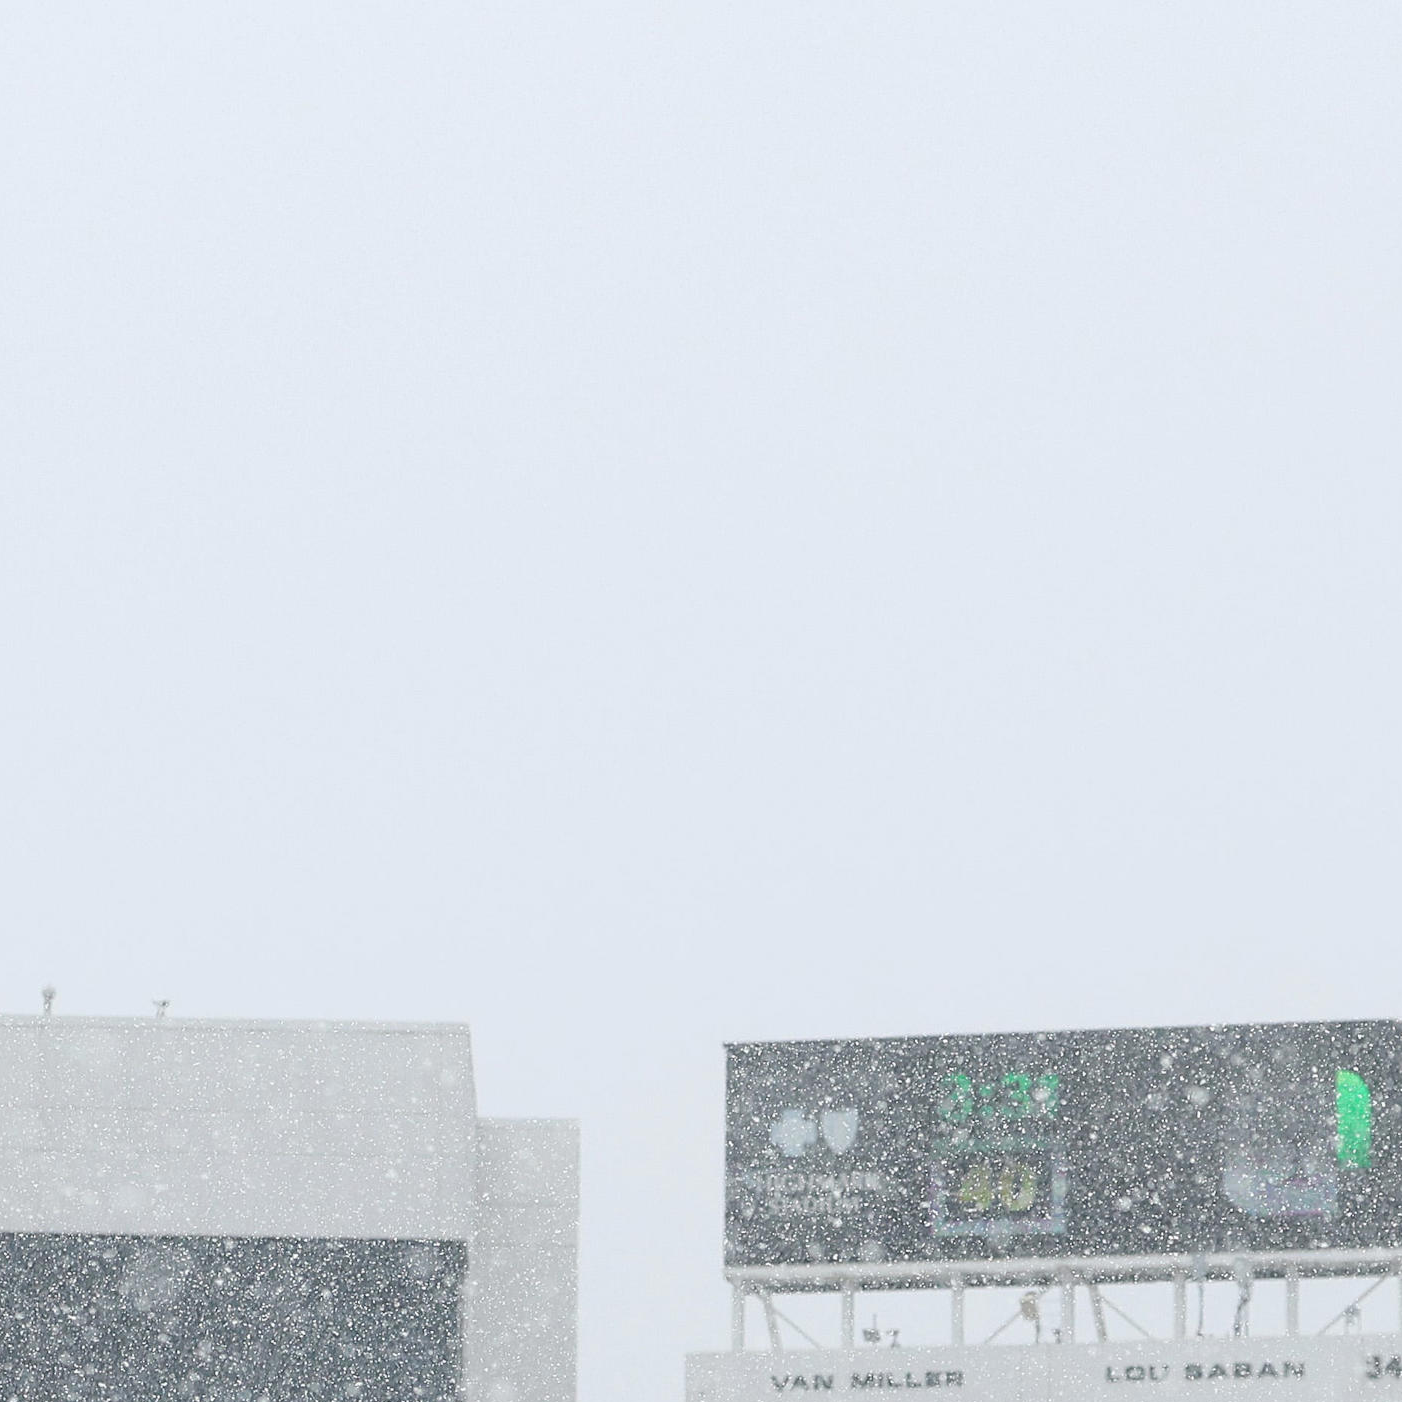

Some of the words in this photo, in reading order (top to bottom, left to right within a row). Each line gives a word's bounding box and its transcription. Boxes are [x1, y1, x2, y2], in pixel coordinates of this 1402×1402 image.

[770, 1373, 835, 1392] VAN
[849, 1370, 965, 1390] MILLER
[1184, 1361, 1306, 1381] SABAN
